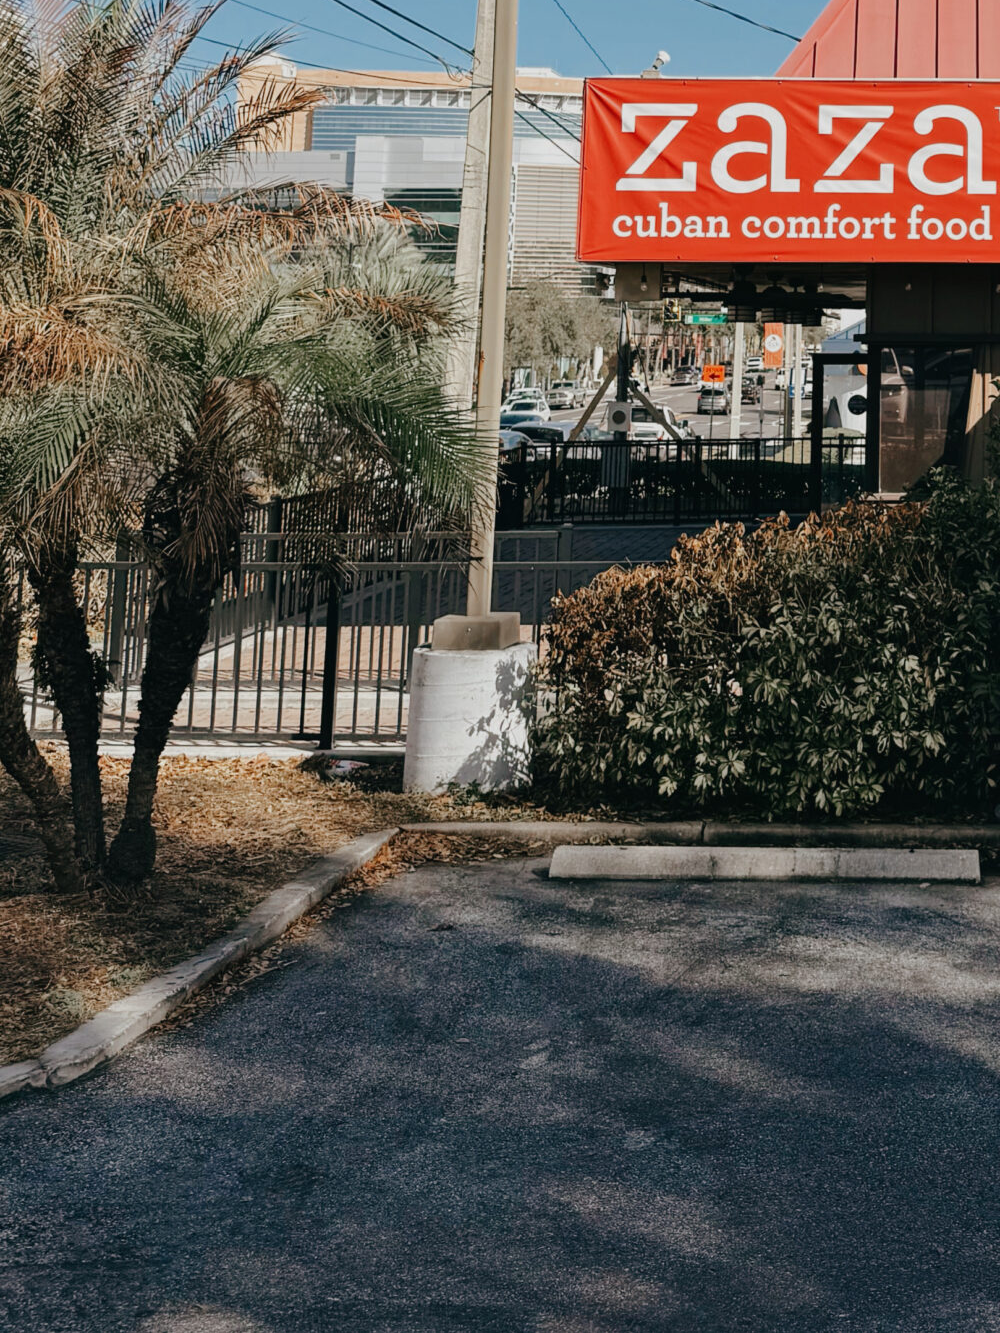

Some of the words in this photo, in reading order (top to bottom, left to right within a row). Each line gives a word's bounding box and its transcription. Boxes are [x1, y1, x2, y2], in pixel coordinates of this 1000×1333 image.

[615, 102, 997, 196] zaza
[612, 202, 731, 238] cuban
[741, 204, 897, 240] comfort
[907, 205, 993, 241] food
